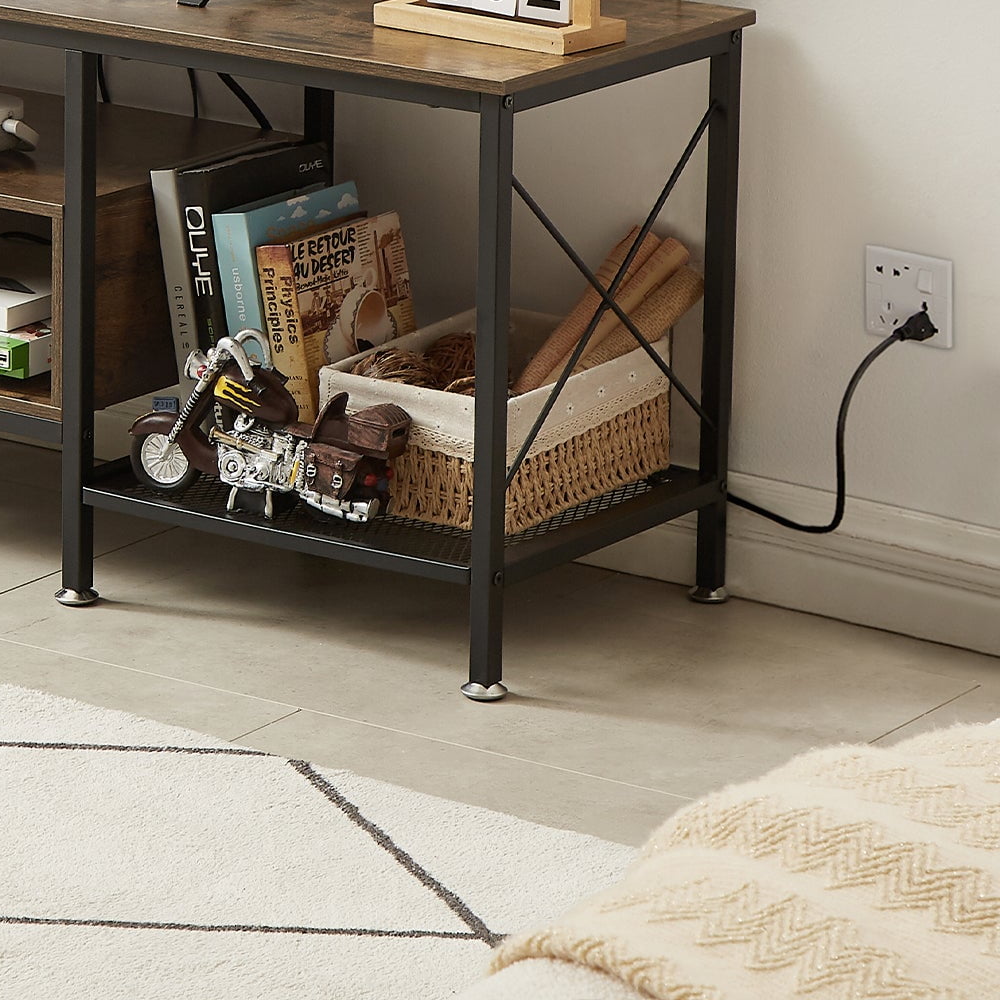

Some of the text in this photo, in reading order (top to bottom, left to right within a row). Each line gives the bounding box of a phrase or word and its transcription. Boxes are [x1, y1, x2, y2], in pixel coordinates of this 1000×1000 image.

[291, 242, 305, 263] LE
[307, 227, 356, 257] RETOUR
[293, 246, 355, 281] AU DESERT
[174, 285, 188, 336] CEREAL
[231, 267, 246, 321] usborne
[262, 267, 284, 354] Principles
[279, 276, 299, 346] Physics
